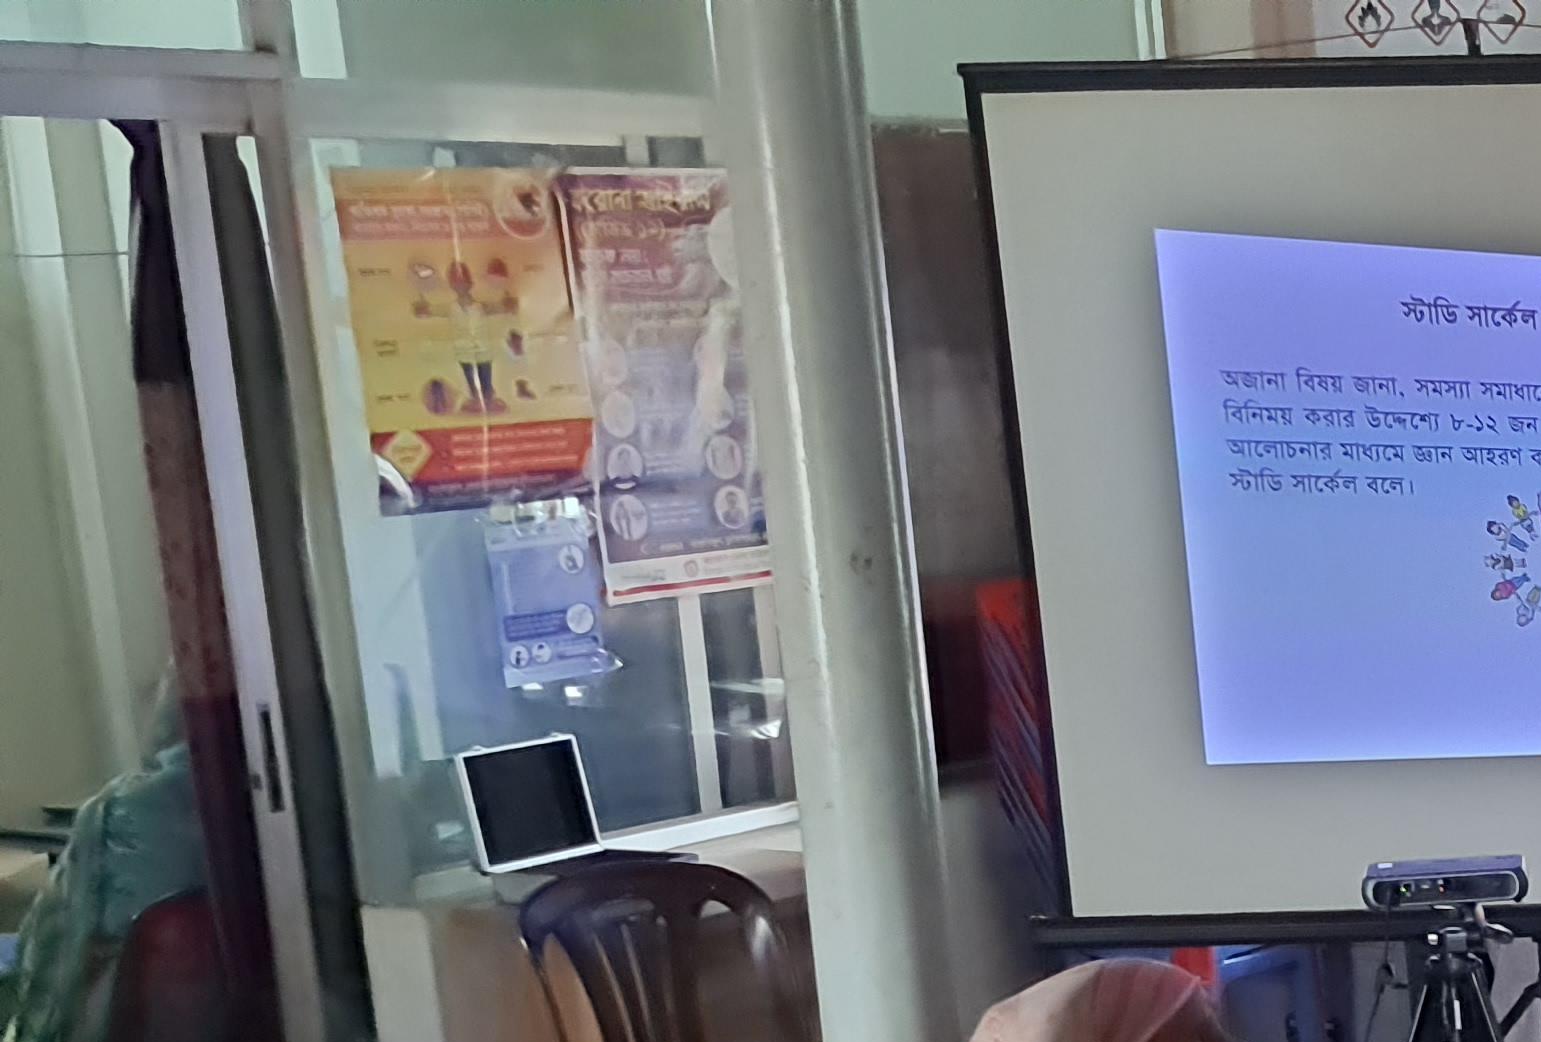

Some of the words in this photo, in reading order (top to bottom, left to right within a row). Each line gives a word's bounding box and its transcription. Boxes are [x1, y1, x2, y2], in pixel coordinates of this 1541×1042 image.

[1401, 295, 1459, 326] স্টাডি
[1465, 300, 1538, 331] সার্কেল
[1219, 369, 1287, 391] অজানা
[1295, 366, 1344, 393] বিষয়
[1414, 378, 1472, 400] সমস্যা
[1223, 398, 1293, 426] বিনিময়
[1303, 407, 1357, 428] করার
[1450, 413, 1501, 436] ৮-১২
[1507, 416, 1539, 434] জন
[1225, 439, 1333, 461] আলোচনার
[1339, 442, 1406, 463] মাধ্যমে
[1411, 445, 1454, 463] জ্ঞান
[1461, 447, 1522, 467] আহরণ
[1229, 466, 1284, 493] স্টাডি
[1290, 469, 1359, 495] সার্কেল
